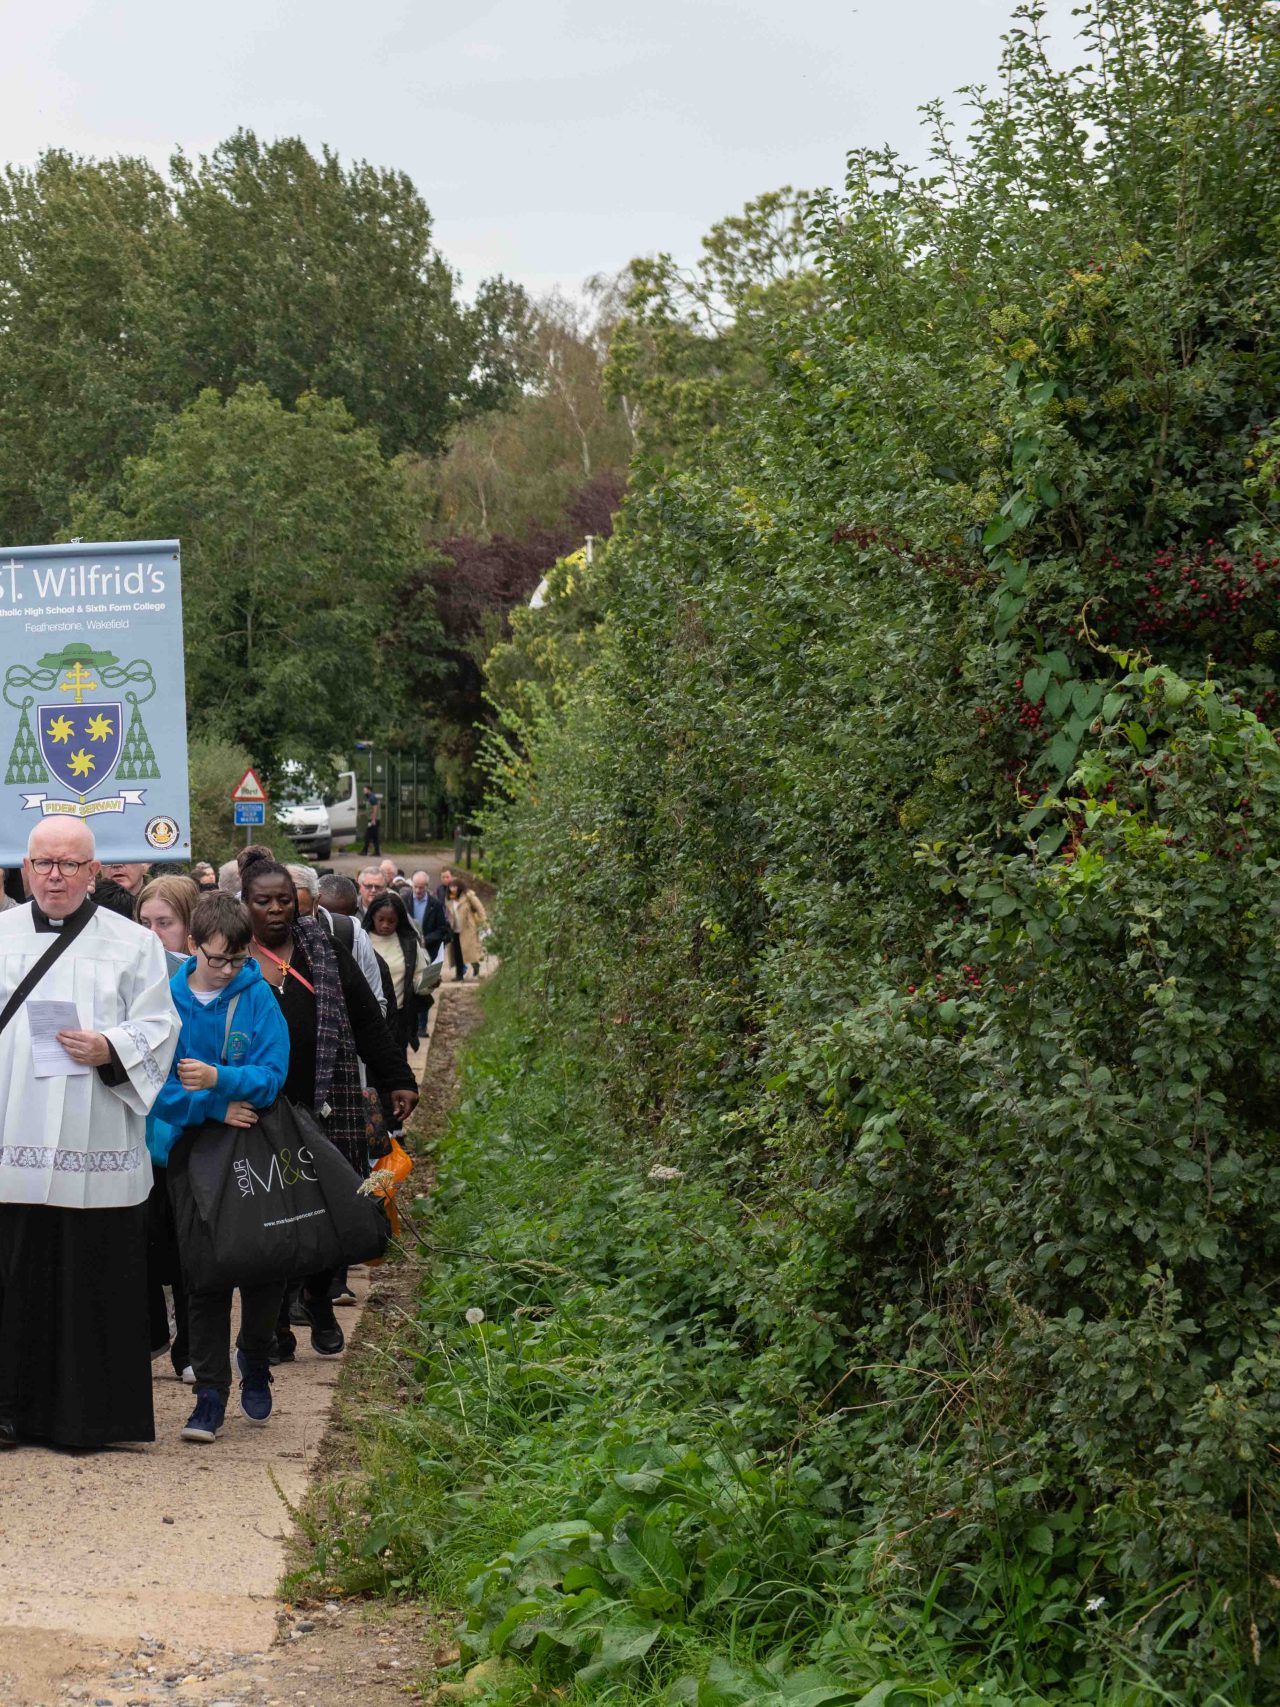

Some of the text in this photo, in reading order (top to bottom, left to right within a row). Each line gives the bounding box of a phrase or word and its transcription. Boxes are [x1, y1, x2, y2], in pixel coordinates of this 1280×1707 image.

[33, 562, 166, 599] Wilfrid's
[24, 607, 44, 617] High
[46, 605, 75, 615] School
[77, 605, 83, 614] &
[85, 604, 107, 613] Sixth
[109, 603, 131, 612] Form
[133, 602, 166, 612] College
[25, 619, 129, 633] Featherstone, Wakefield
[45, 800, 122, 815] FIDEM SERVAVI
[232, 1146, 319, 1198] YOUR M&S
